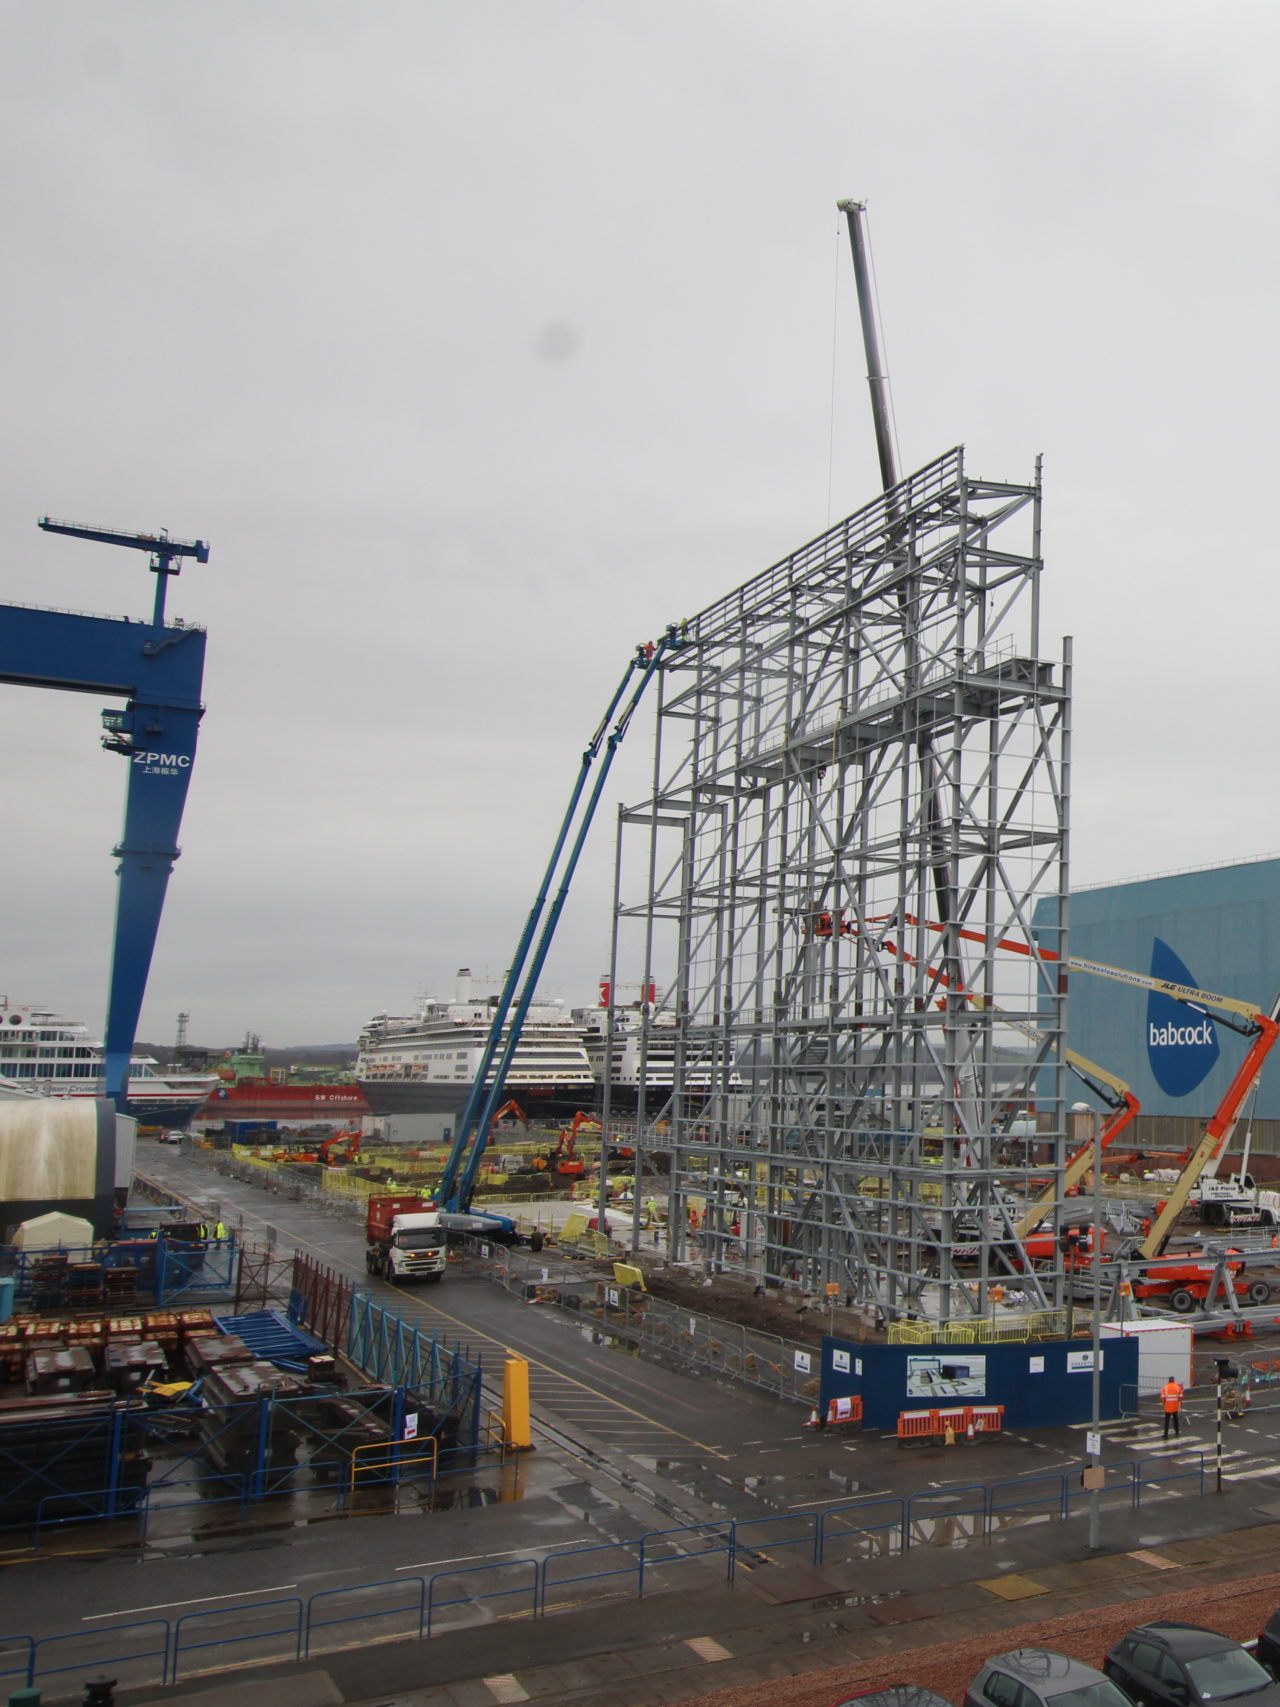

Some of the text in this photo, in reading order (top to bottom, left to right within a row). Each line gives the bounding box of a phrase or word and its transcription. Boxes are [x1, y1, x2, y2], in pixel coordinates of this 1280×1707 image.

[133, 751, 190, 767] ZPMC
[1161, 982, 1224, 1004] JLG ULTRA BOOM
[1150, 1020, 1213, 1047] babcock
